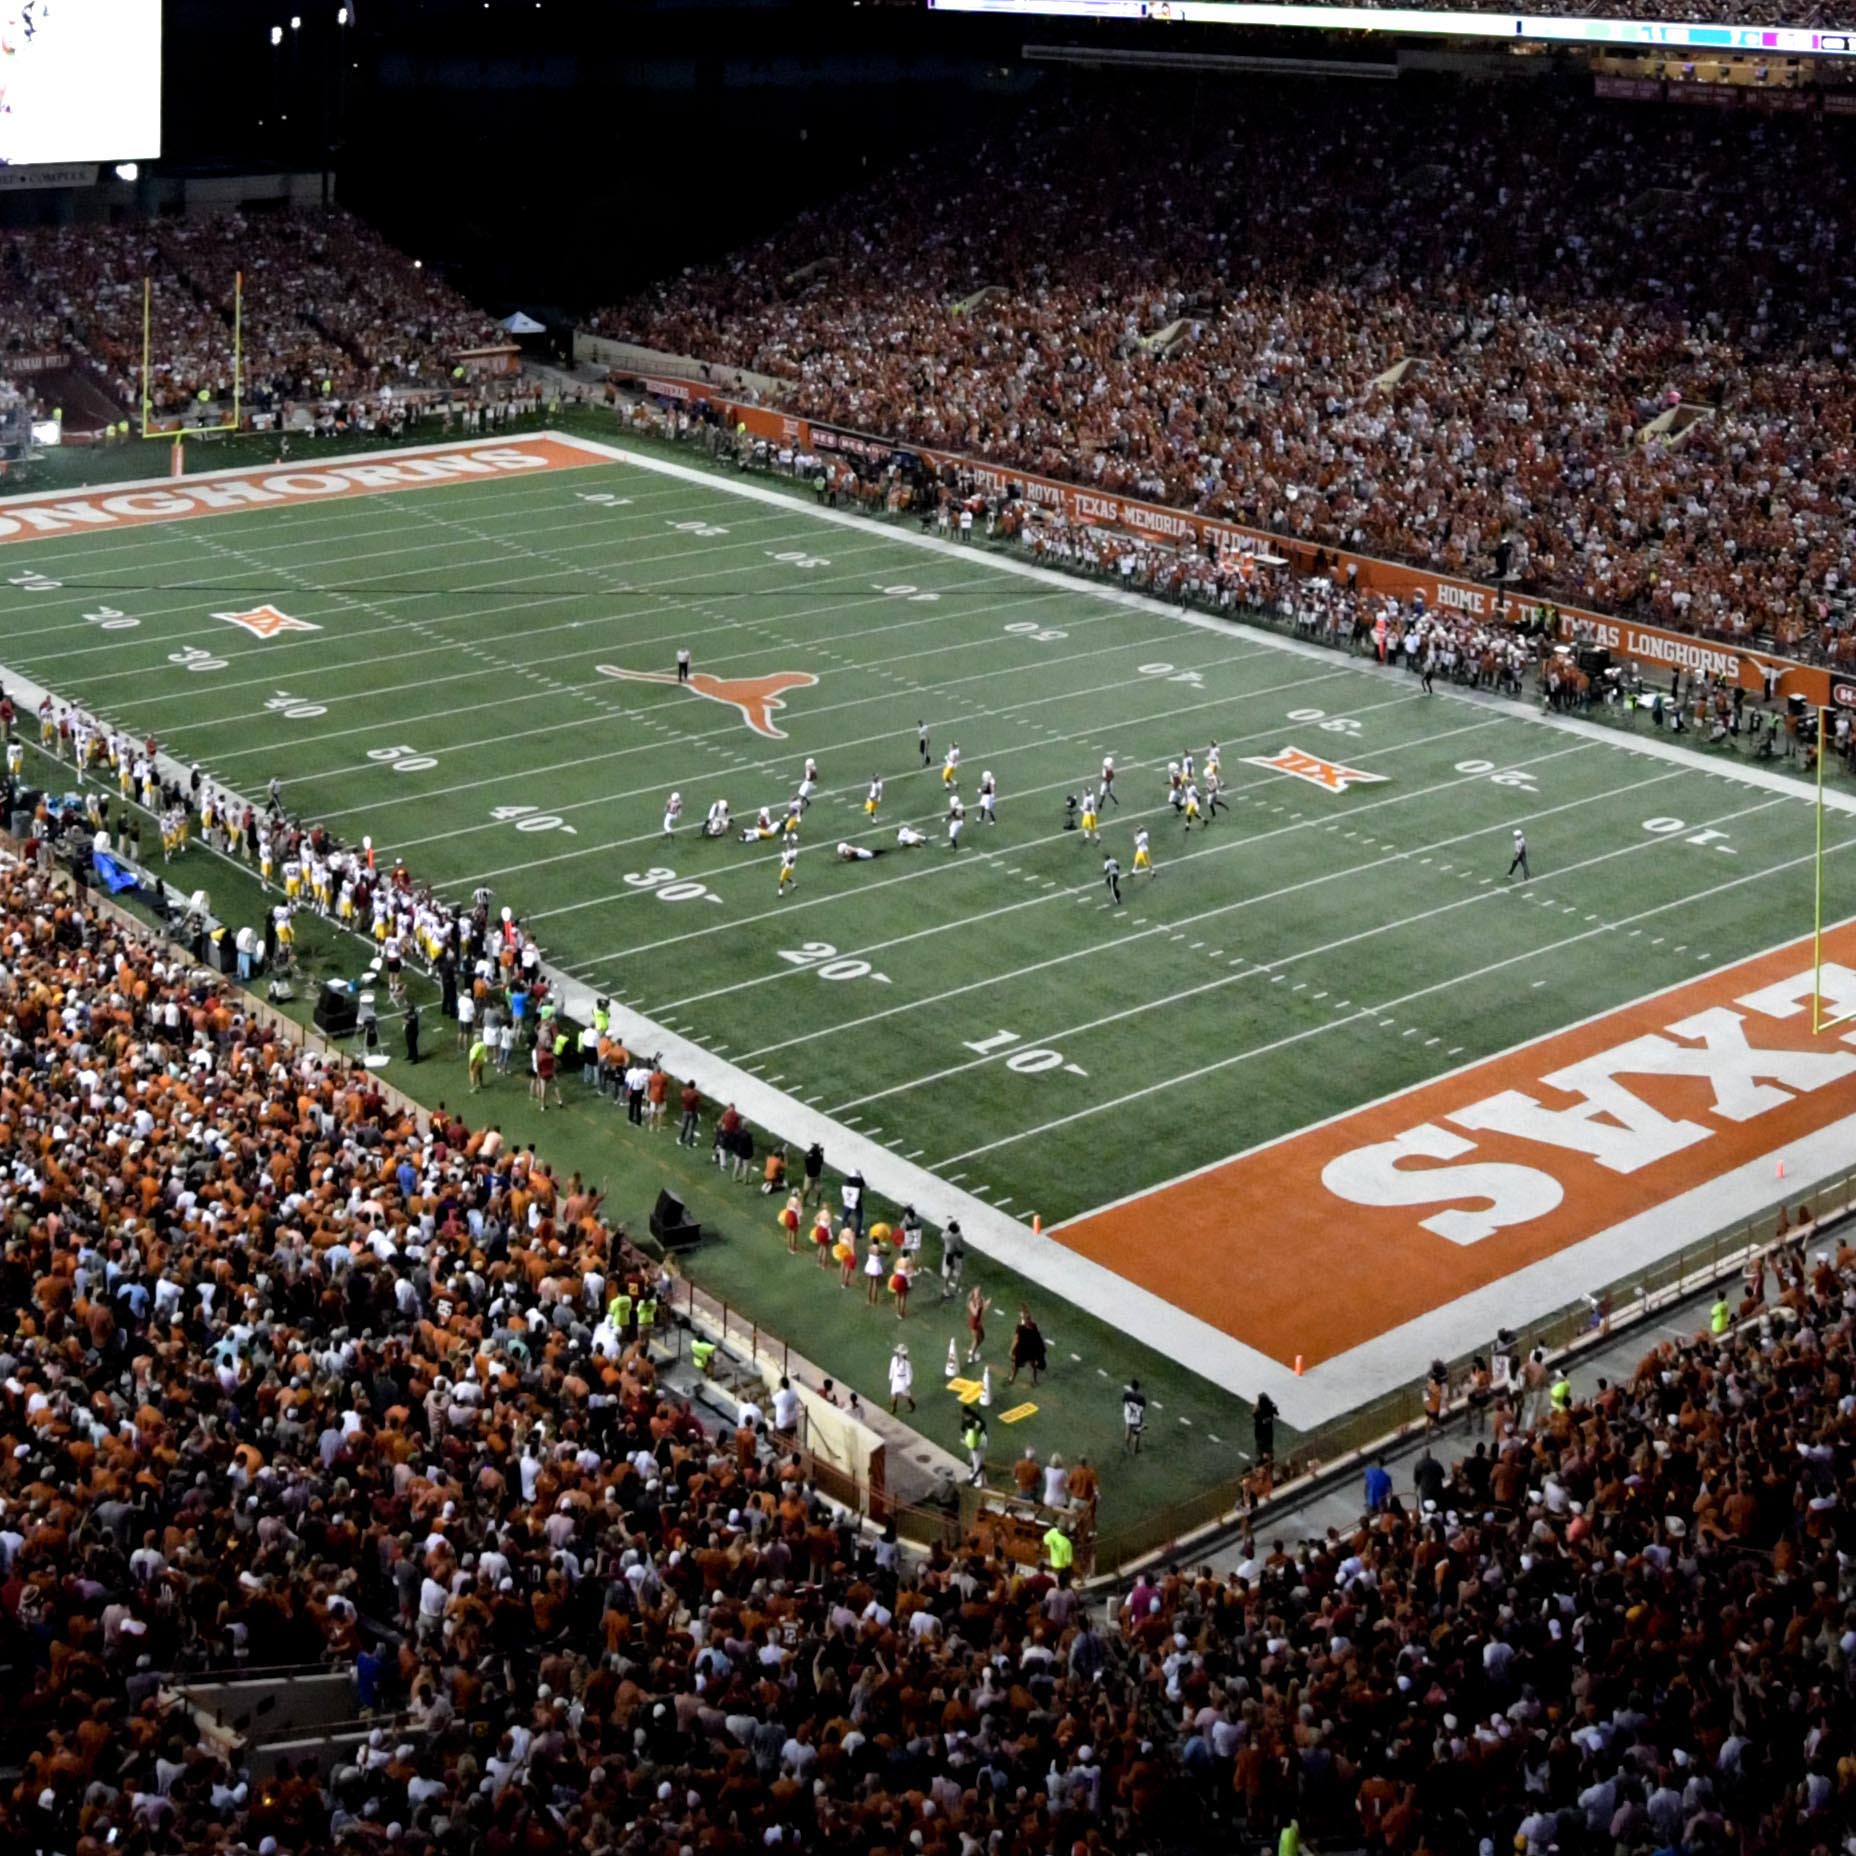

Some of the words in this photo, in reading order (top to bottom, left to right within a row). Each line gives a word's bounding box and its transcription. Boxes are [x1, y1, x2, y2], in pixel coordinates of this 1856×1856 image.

[29, 172, 86, 184] COMPLEX
[584, 493, 633, 506] 10
[675, 521, 730, 536] 20
[1124, 505, 1196, 538] MEMORIA
[774, 552, 831, 568] 30
[8, 574, 62, 591] 10
[883, 585, 941, 601] 40
[82, 607, 141, 629] 20
[1004, 622, 1069, 641] 50
[1437, 584, 1485, 613] HOME
[1627, 630, 1739, 679] LONGHORNS
[168, 647, 229, 671] 30
[1137, 663, 1203, 682] 40
[263, 697, 328, 718] 40
[1286, 709, 1362, 734] 30
[366, 745, 439, 772] 50
[1455, 760, 1539, 787] 20
[489, 806, 564, 832] 40
[1642, 817, 1731, 845] 10
[623, 867, 708, 902] 30
[777, 941, 872, 981] 20
[961, 1029, 1064, 1074] 10
